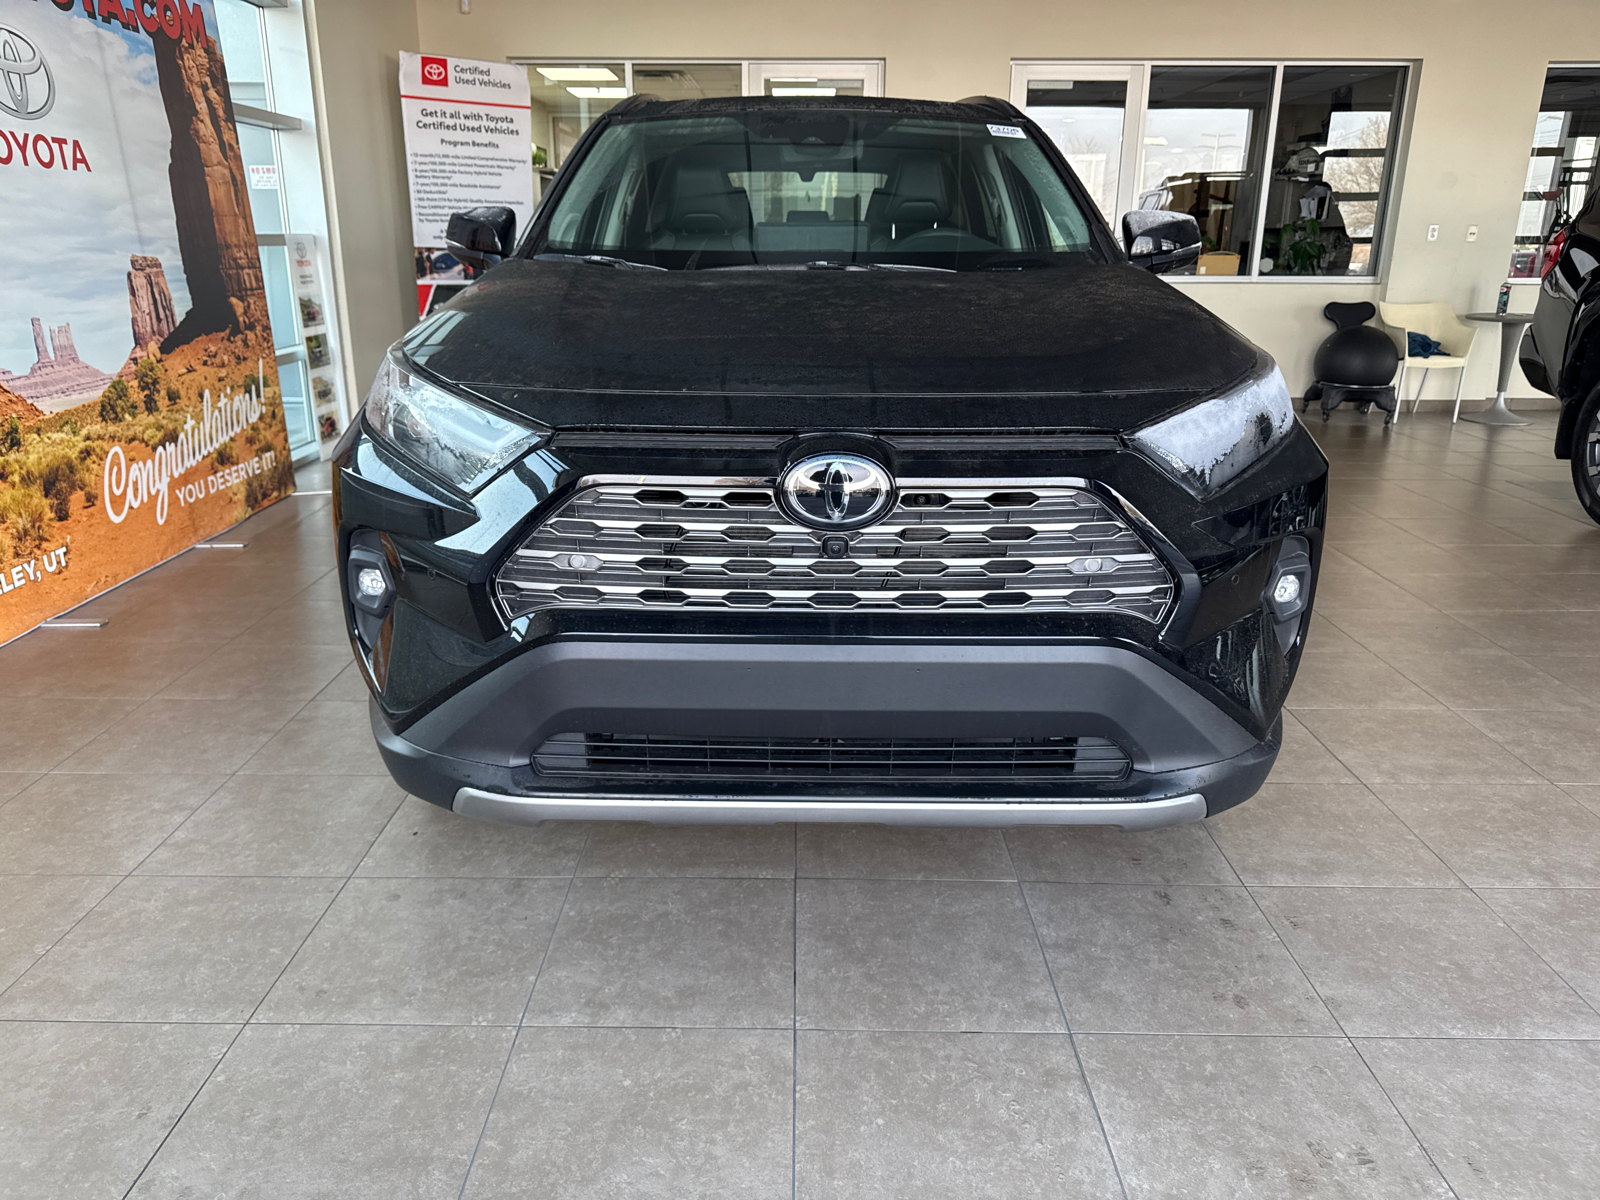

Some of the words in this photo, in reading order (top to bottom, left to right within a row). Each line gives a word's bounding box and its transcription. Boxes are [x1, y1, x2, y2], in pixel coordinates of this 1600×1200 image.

[454, 65, 490, 76] Certified
[455, 76, 477, 85] Used
[478, 80, 511, 90] Vehicles
[421, 108, 438, 118] Get
[440, 108, 448, 119] it
[449, 110, 461, 120] all
[462, 111, 484, 121] with
[484, 113, 514, 125] Toyota
[416, 120, 458, 131] Certified
[459, 123, 482, 134] Used
[483, 126, 520, 136] Vehicles
[440, 138, 470, 149] Program
[471, 140, 500, 149] Benefits
[104, 358, 266, 526] Congratulations!
[175, 479, 206, 507] YOU
[207, 456, 262, 495] DESERVE
[261, 450, 277, 472] IT!
[0, 558, 42, 596] LEY,
[42, 545, 68, 574] UT
